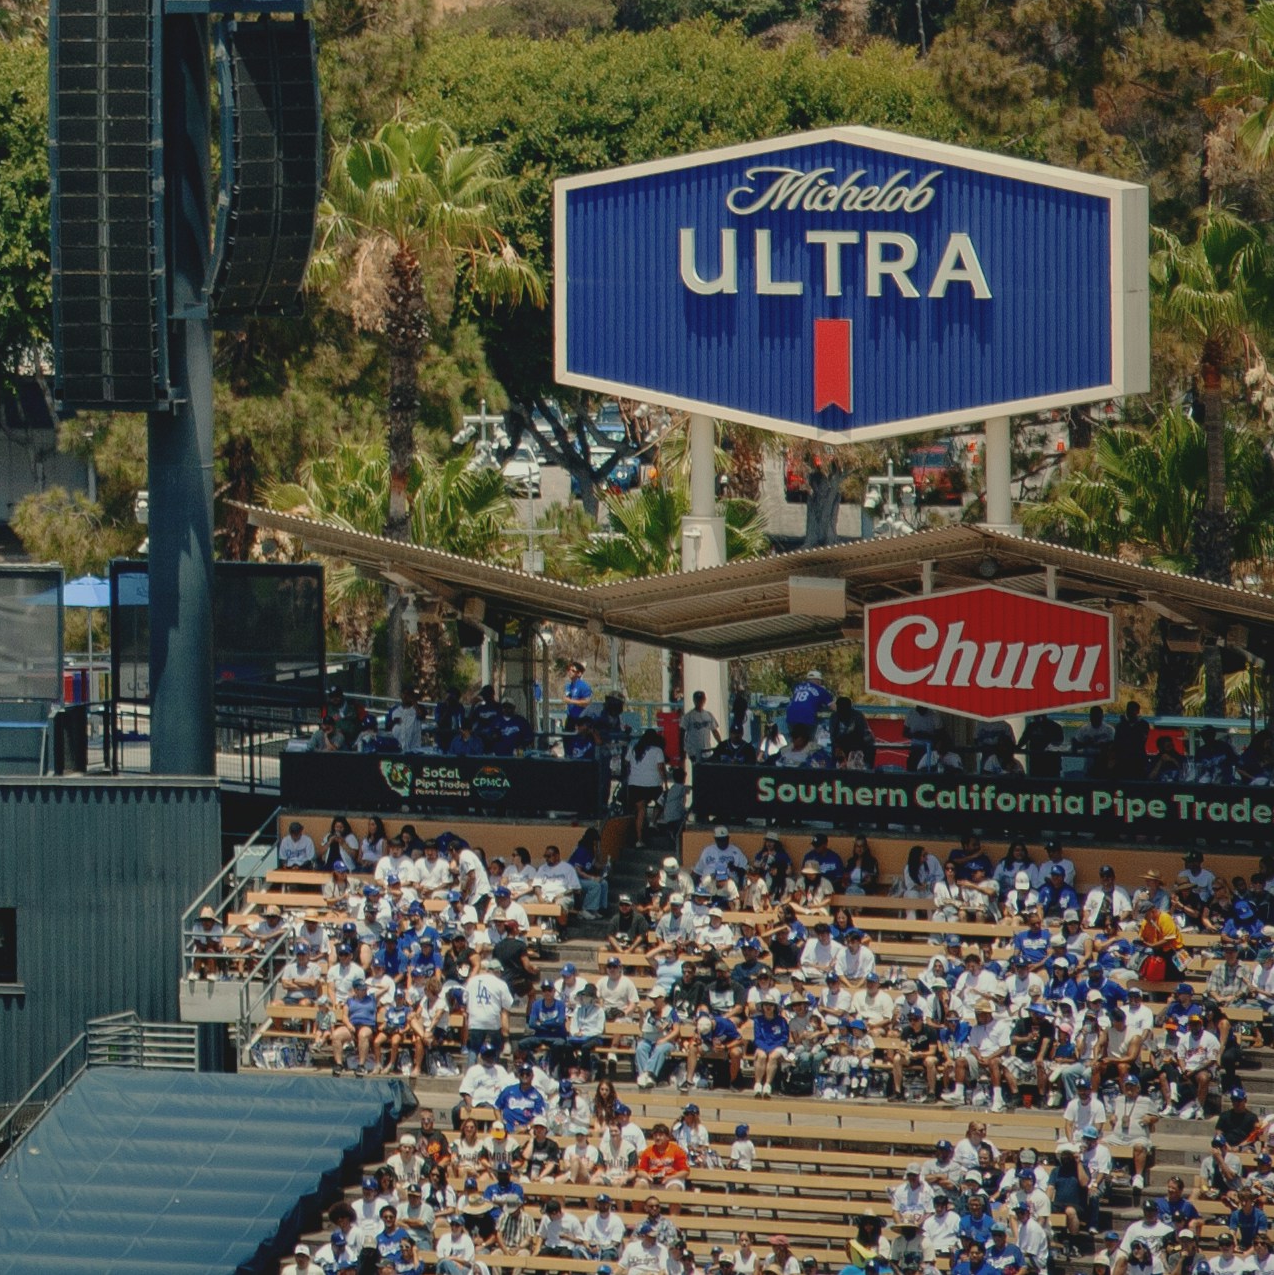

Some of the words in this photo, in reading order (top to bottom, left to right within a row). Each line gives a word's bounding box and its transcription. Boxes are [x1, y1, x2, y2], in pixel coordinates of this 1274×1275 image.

[726, 166, 944, 215] Michelob
[679, 227, 993, 299] ULTRA
[875, 614, 1102, 693] Churu
[794, 691, 809, 703] 18
[415, 779, 437, 790] Pipe
[439, 779, 470, 790] Trades
[422, 767, 460, 779] SoCal
[472, 777, 511, 788] CPMCA
[757, 777, 909, 808] Southern
[914, 783, 1085, 815] California
[1091, 790, 1168, 824] Pipe
[1172, 793, 1274, 825] Trade
[476, 980, 492, 1006] LA
